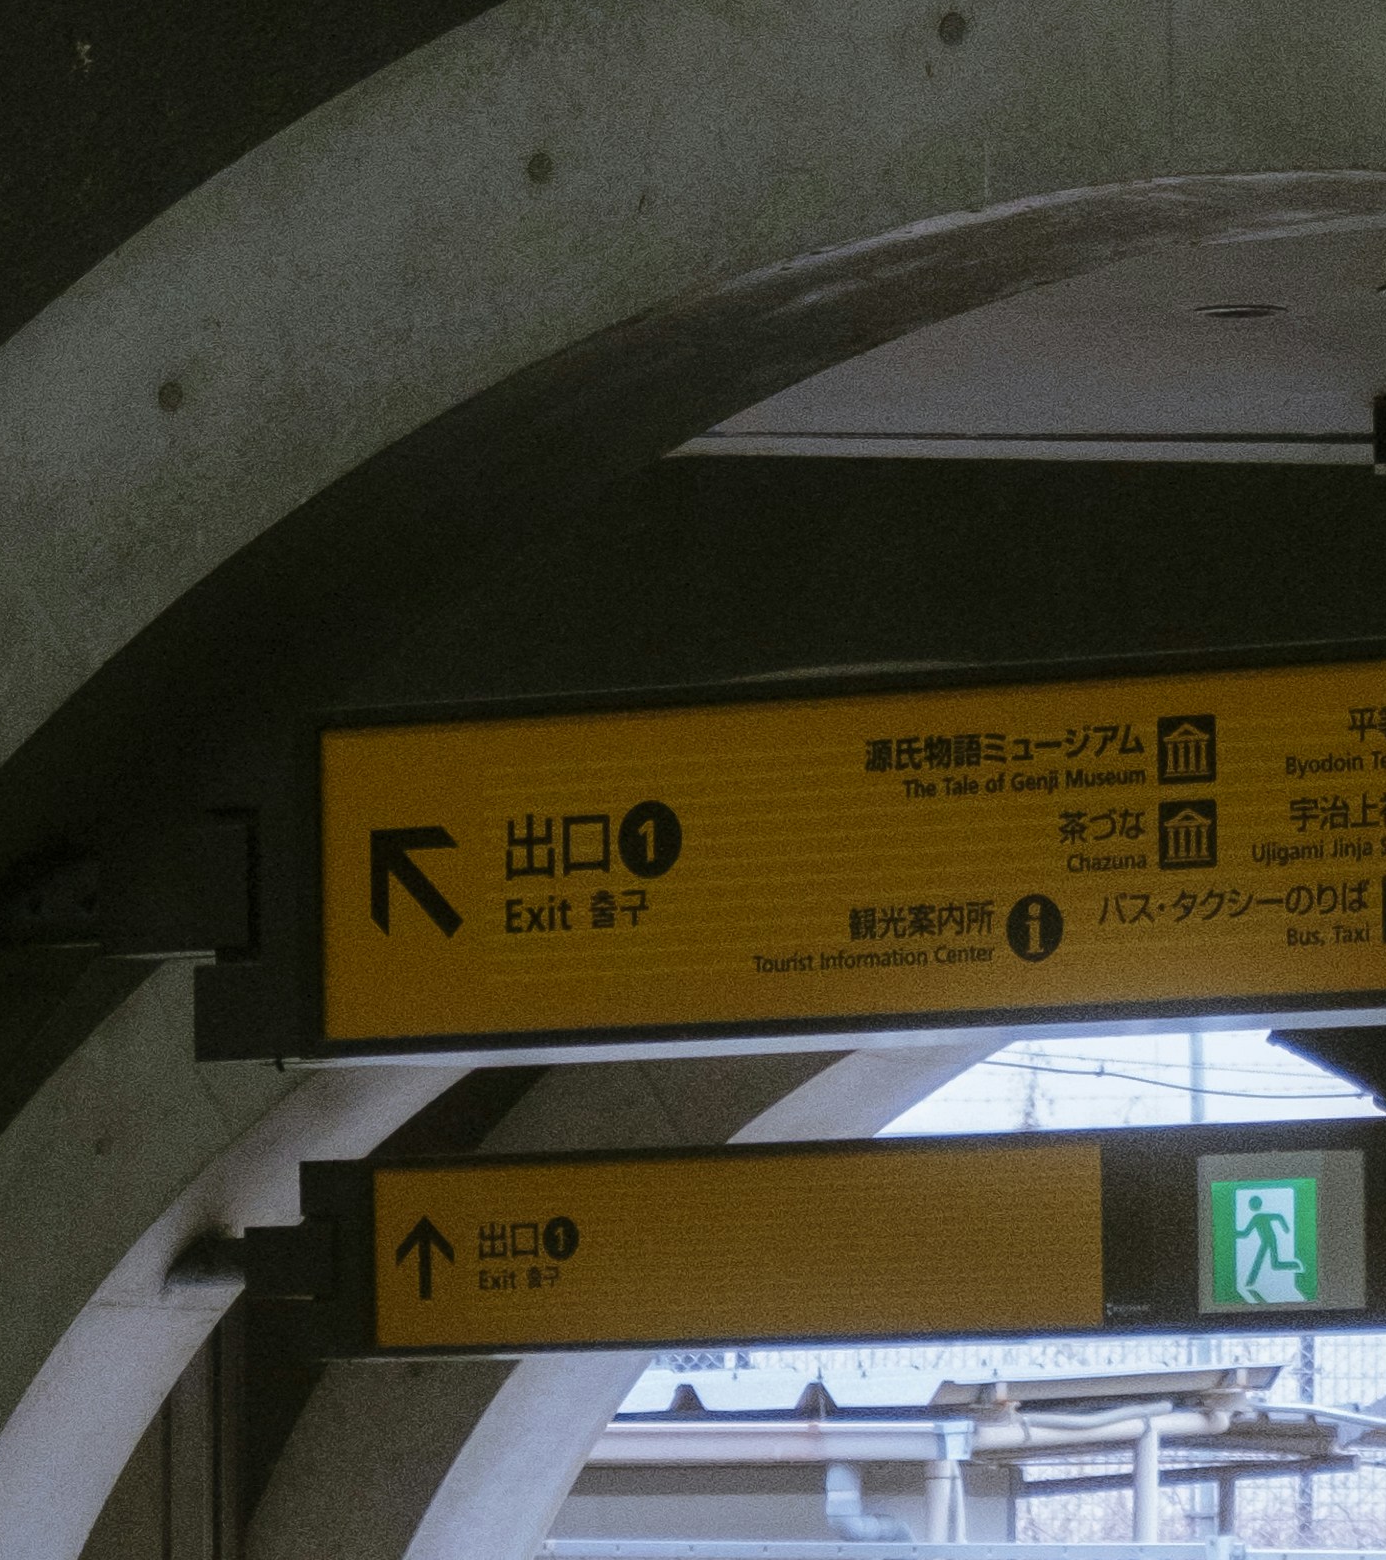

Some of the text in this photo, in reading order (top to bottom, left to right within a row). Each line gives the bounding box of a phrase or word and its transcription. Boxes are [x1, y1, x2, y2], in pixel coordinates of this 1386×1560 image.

[865, 724, 1146, 774] 源氏物語ミュージアム
[1285, 753, 1364, 777] Byodoin
[903, 766, 1147, 799] The Tale of Genji Museum
[1059, 808, 1146, 845] 茶づな
[1067, 851, 1147, 874] Chazuna
[1251, 837, 1324, 866] Ujigami
[1331, 836, 1374, 860] Jinja
[505, 889, 650, 935] Exit 출구
[849, 901, 994, 941] 観光案内所
[1333, 923, 1370, 945] Taxi
[753, 945, 995, 975] Tourist Information Center
[478, 1269, 517, 1291] Exit
